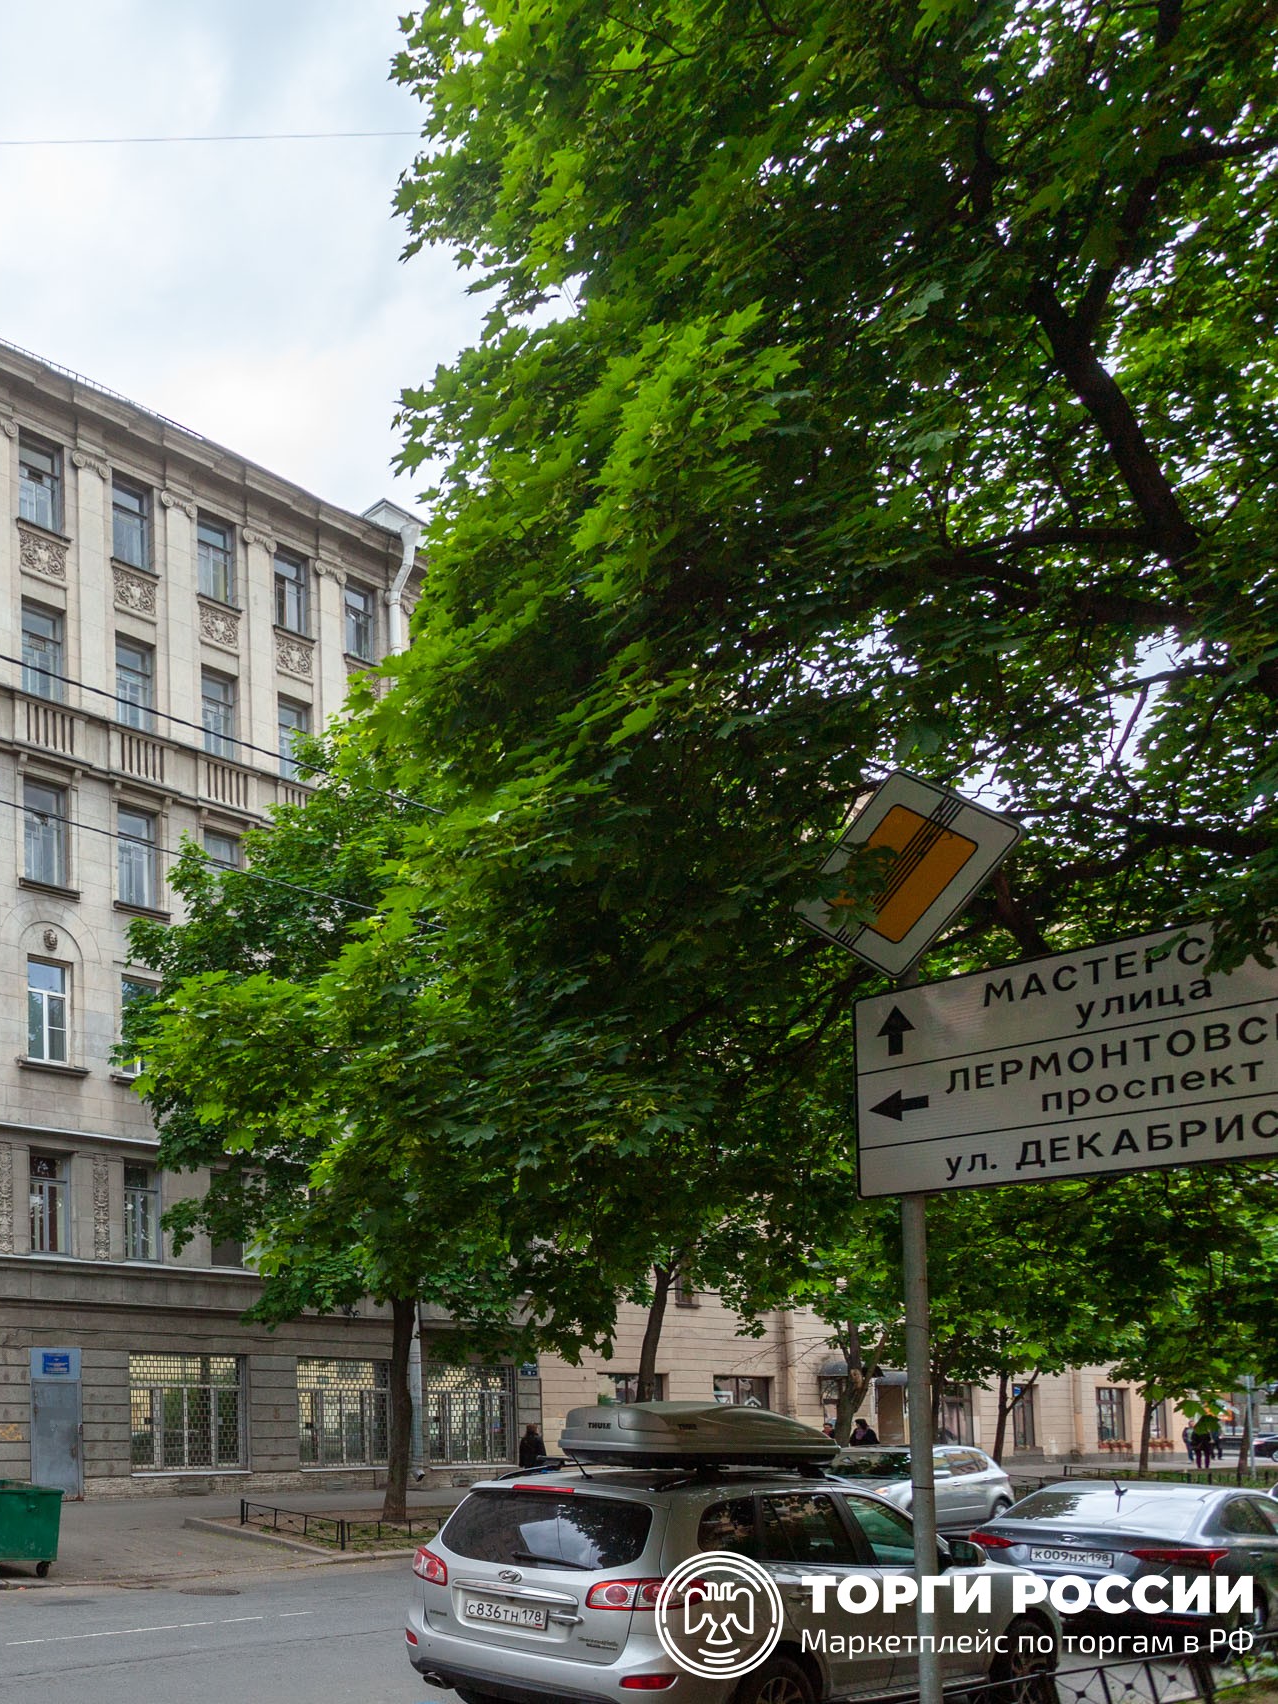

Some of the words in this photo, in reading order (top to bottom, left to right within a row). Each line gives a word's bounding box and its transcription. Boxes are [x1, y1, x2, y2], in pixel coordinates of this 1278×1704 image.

[983, 937, 1206, 1007] МАСТЕРС
[1076, 979, 1213, 1029] улица
[945, 1012, 1278, 1095] ЛЕРМОНТОВС
[1042, 1060, 1264, 1115] проспект
[945, 1153, 998, 1181] ул.
[588, 1422, 611, 1430] THULE
[522, 1610, 542, 1622] 178
